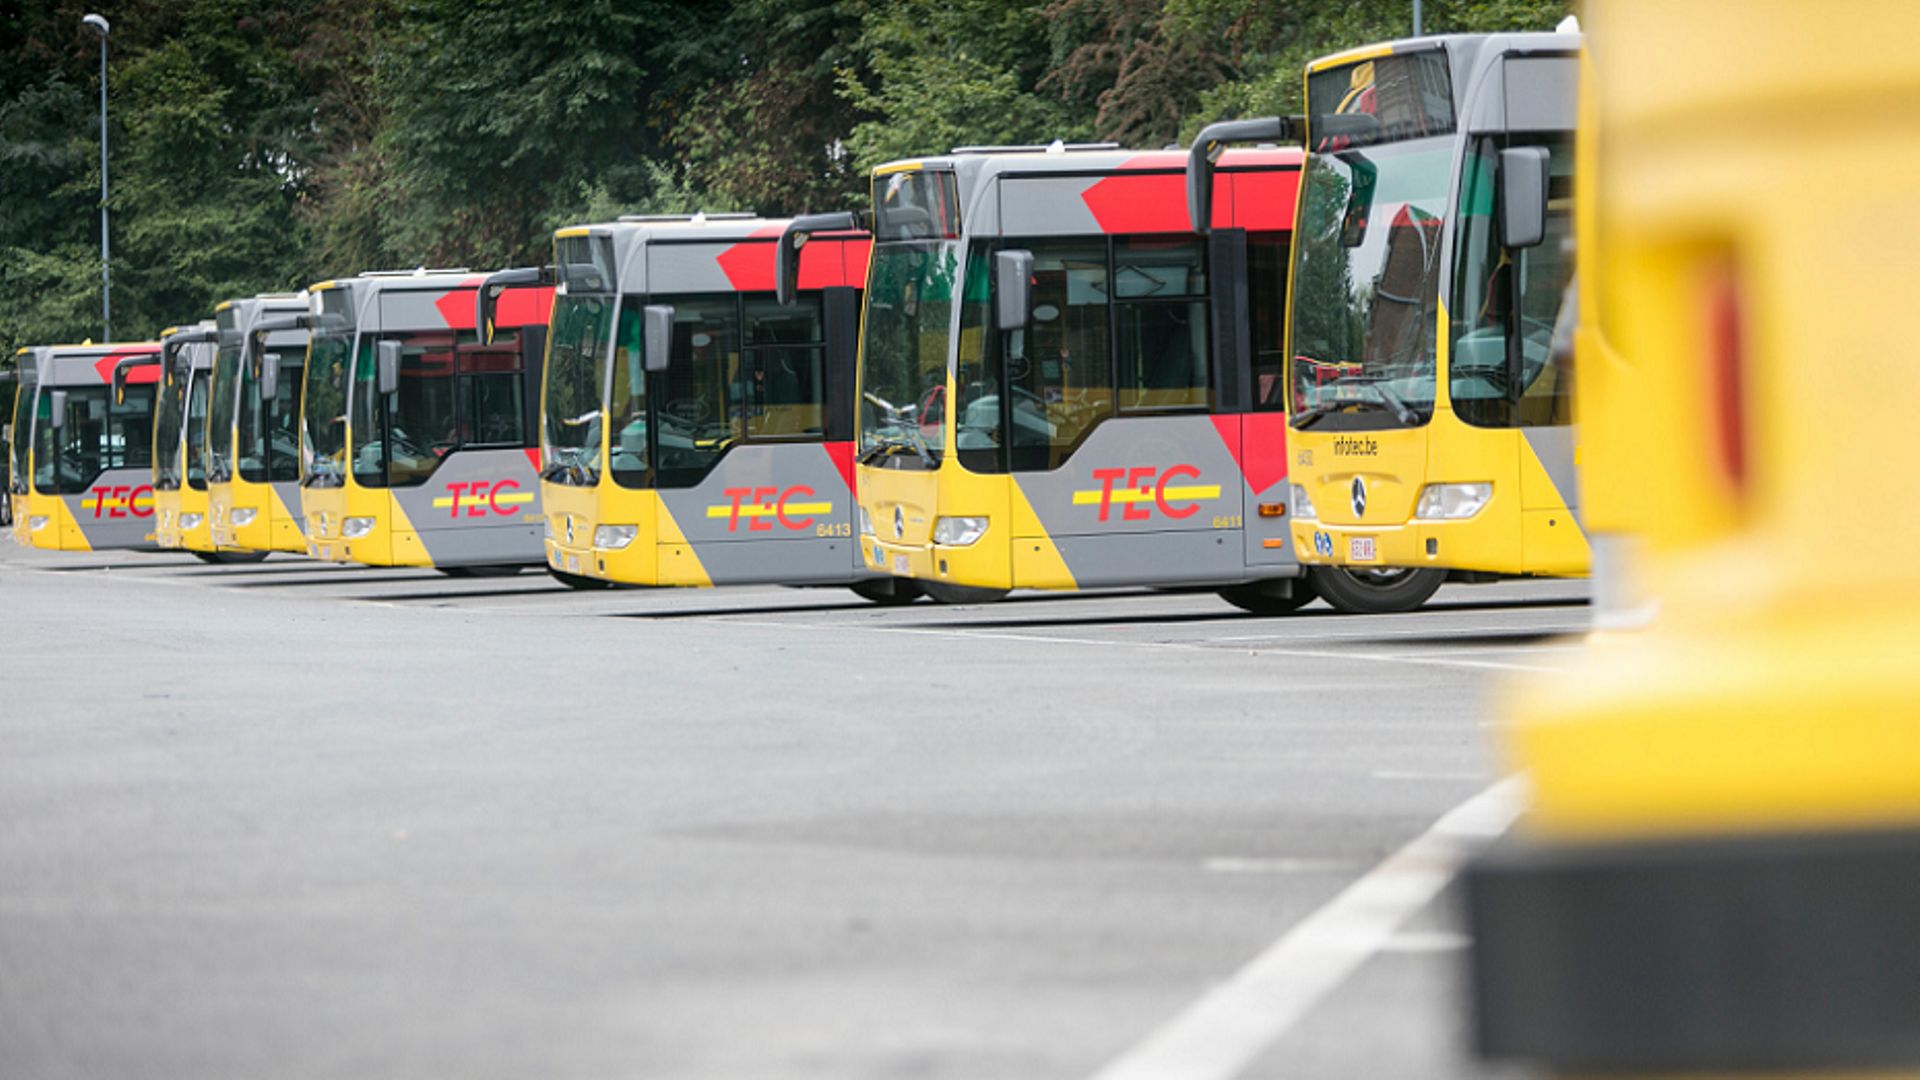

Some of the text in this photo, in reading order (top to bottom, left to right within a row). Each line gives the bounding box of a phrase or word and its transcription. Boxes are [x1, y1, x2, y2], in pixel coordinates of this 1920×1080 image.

[91, 484, 155, 519] TEC
[446, 479, 520, 519] TEC
[723, 485, 815, 532] TEC
[1093, 464, 1201, 522] TEC
[816, 523, 851, 537] 6413
